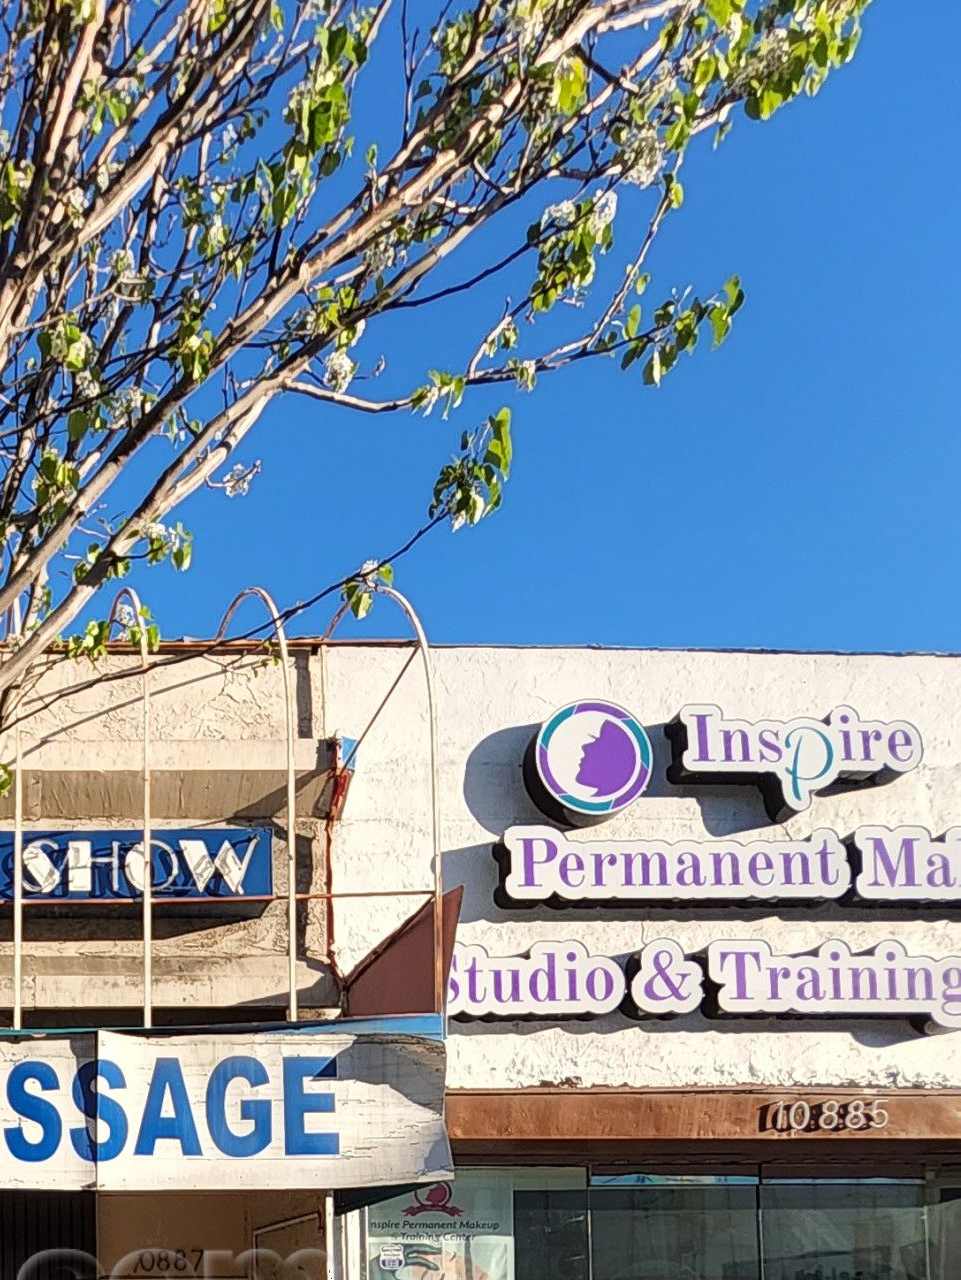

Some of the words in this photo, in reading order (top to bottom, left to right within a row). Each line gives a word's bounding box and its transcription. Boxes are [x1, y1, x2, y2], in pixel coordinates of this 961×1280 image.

[689, 713, 913, 801] Inspire
[20, 838, 260, 894] SHOW
[515, 837, 839, 888] Permanent
[865, 837, 961, 888] Ma
[448, 951, 614, 1004] Studio
[644, 950, 691, 1001] &
[719, 951, 961, 1016] Training
[776, 1100, 889, 1130] 10885
[369, 1220, 400, 1231] nspire
[402, 1220, 457, 1229] Permanent
[459, 1220, 500, 1231] Makeup
